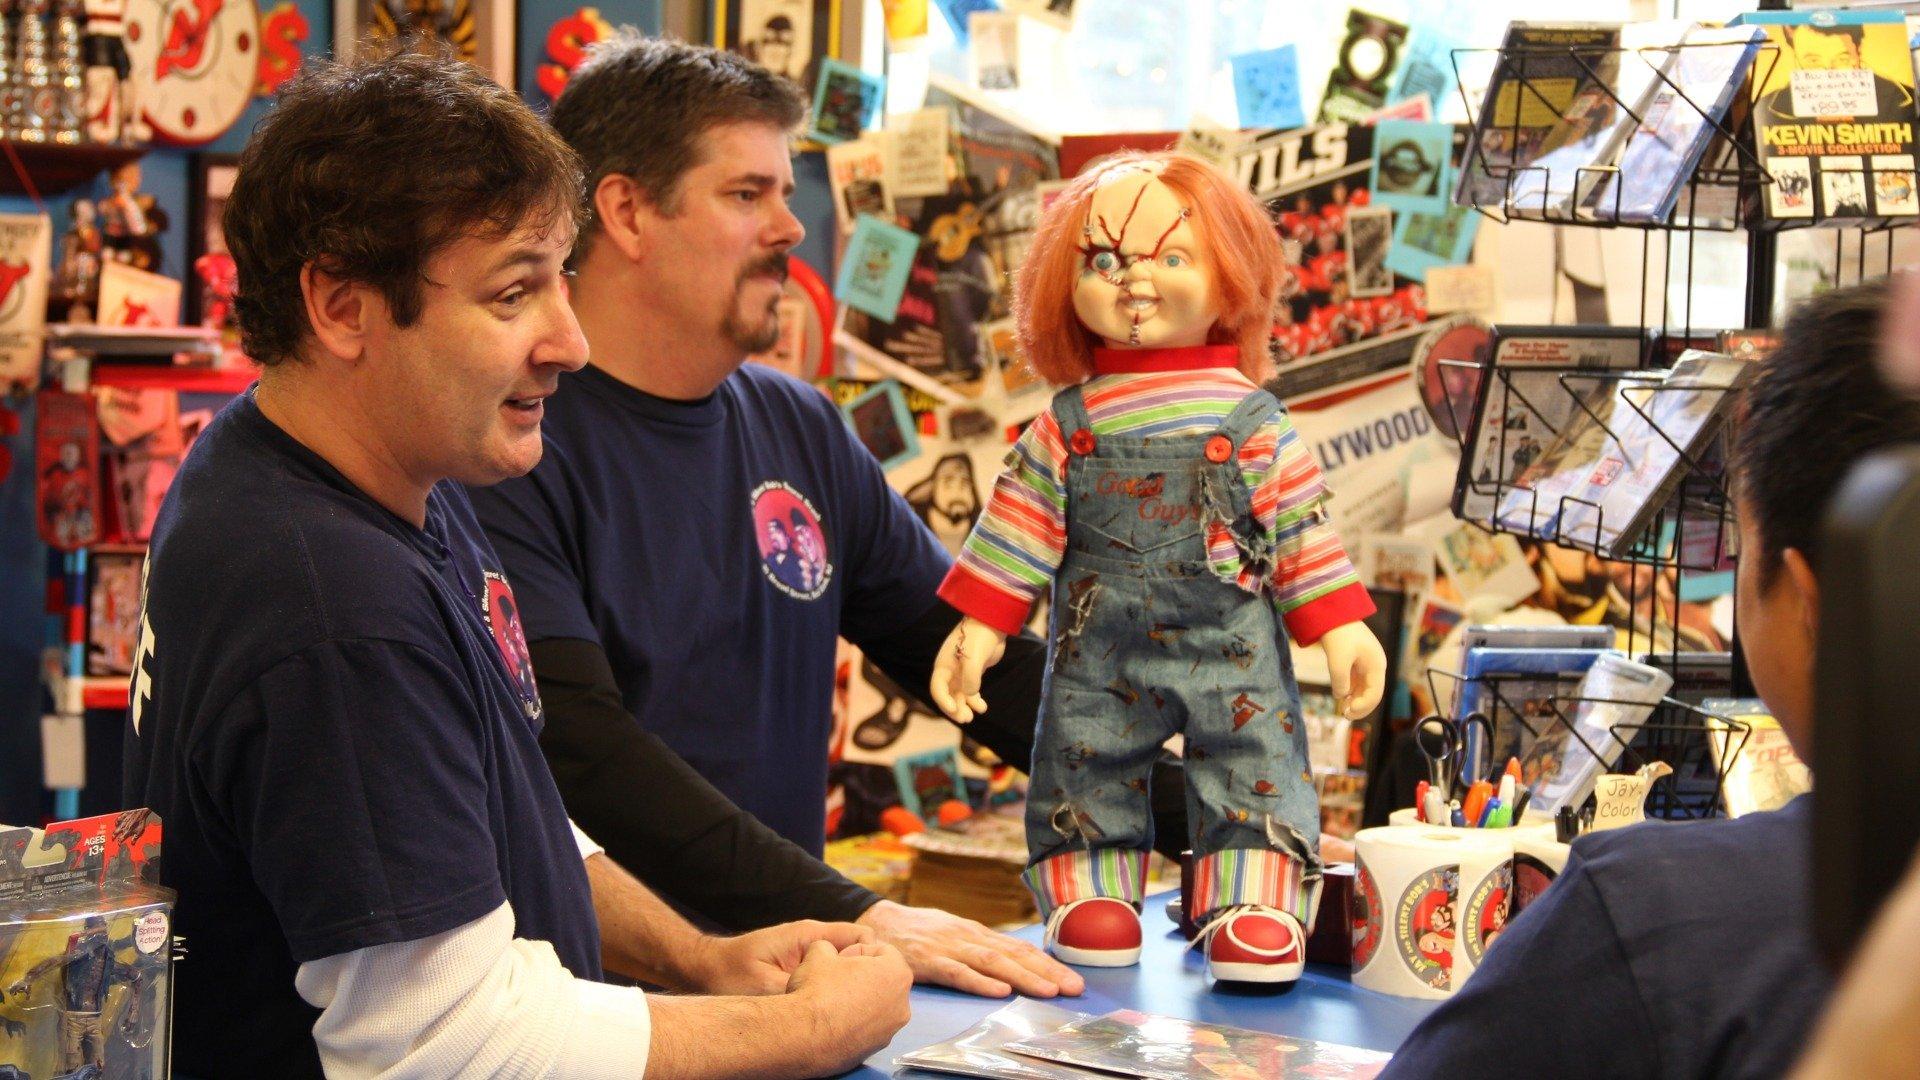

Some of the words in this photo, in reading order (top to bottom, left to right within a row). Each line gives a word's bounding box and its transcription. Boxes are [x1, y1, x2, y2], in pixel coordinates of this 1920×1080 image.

[1762, 124, 1835, 146] KEVIN
[1838, 122, 1913, 145] SMITH
[1778, 143, 1826, 156] 3-MOVIE
[1828, 142, 1902, 155] COLLECTION
[1601, 802, 1636, 817] Color
[84, 835, 106, 847] AGES
[88, 845, 105, 857] 13+
